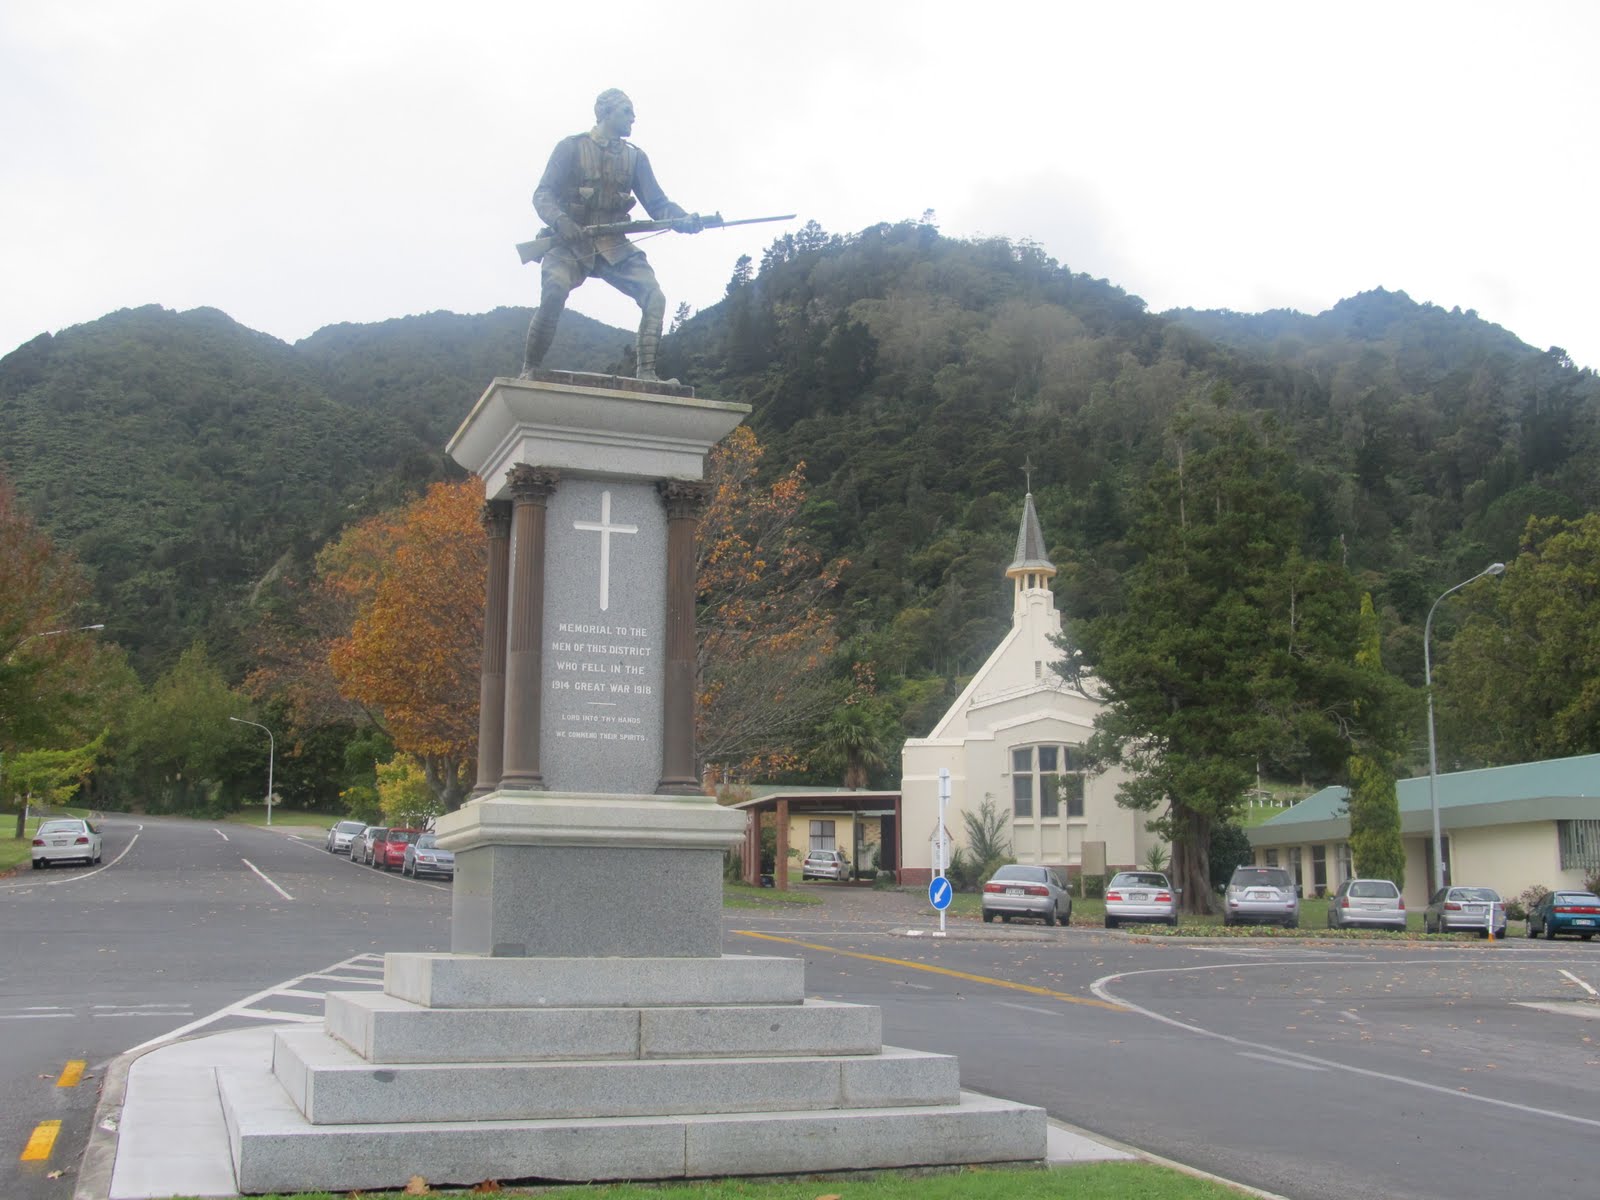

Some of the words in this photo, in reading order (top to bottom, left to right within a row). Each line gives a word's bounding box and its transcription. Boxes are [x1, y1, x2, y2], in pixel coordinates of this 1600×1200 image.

[559, 623, 612, 634] MEMORIAL
[616, 627, 626, 635] TO
[630, 628, 647, 636] THE
[552, 642, 571, 651] MEN
[587, 644, 607, 654] THIS
[609, 646, 651, 656] DISTRICT
[557, 662, 577, 670] WHO
[582, 663, 606, 672] FELL
[611, 665, 620, 673] IN
[625, 666, 645, 675] THE
[552, 680, 569, 689] 1914
[575, 682, 605, 692] GREAT
[610, 684, 630, 693] WAR
[634, 685, 651, 694] 1918
